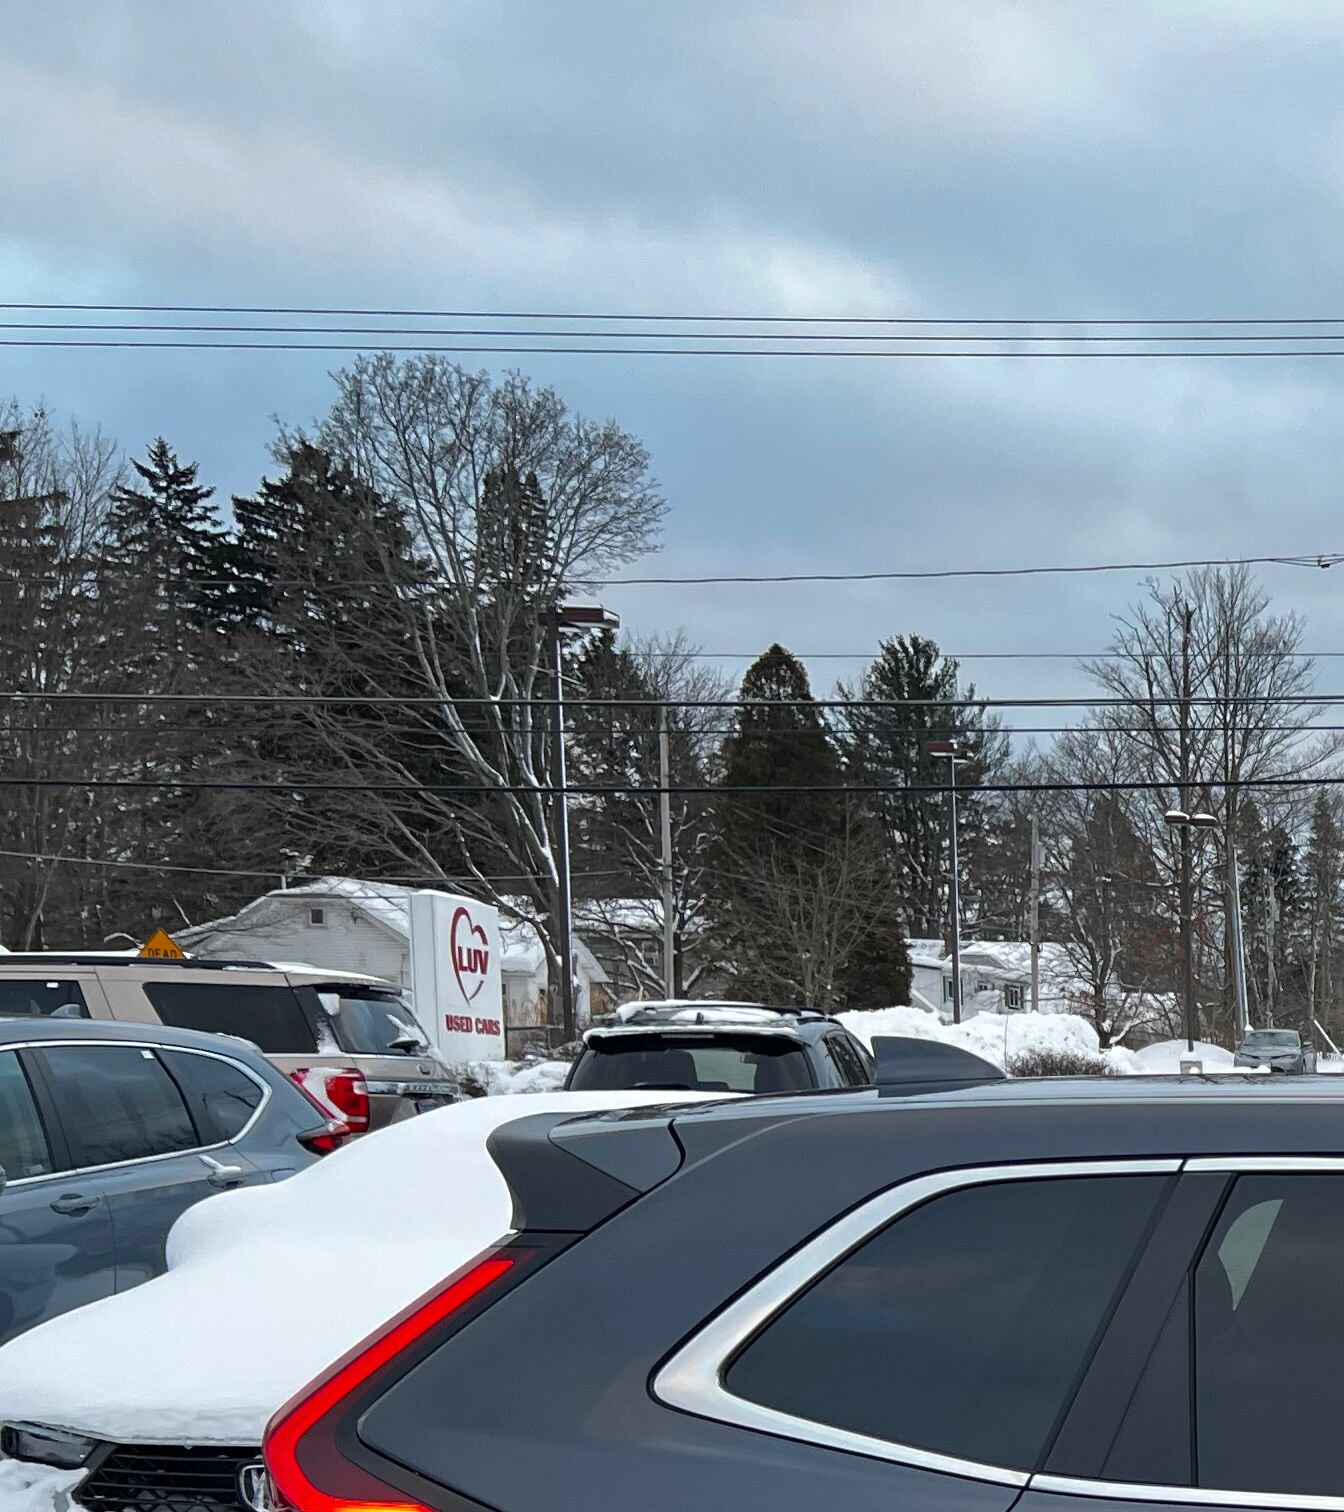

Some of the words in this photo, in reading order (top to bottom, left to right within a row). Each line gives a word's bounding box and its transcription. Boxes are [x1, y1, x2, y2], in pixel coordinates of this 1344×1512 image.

[147, 948, 177, 959] DEAD
[457, 946, 489, 975] LUV
[445, 1014, 473, 1033] USED
[475, 1017, 501, 1036] CARS
